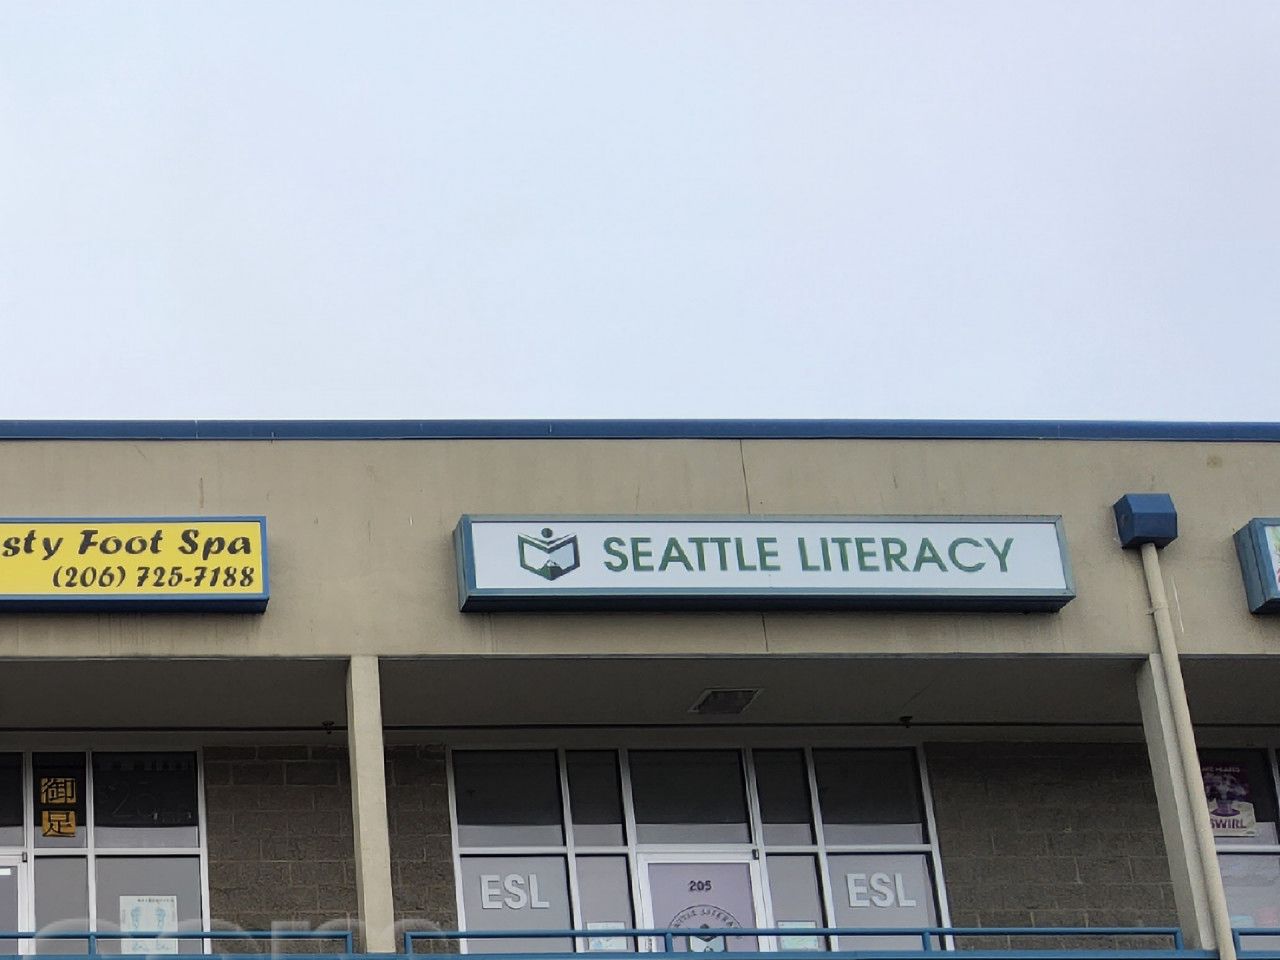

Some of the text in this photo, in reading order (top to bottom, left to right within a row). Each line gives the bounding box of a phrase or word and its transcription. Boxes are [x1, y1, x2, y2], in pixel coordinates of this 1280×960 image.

[78, 529, 163, 554] Foot
[178, 529, 252, 560] Spa
[603, 536, 1015, 573] SEATTLE LITERACY
[52, 566, 255, 588] (206) 725-7188
[479, 873, 550, 909] ESL
[688, 880, 712, 892] 205
[846, 872, 917, 907] ESL
